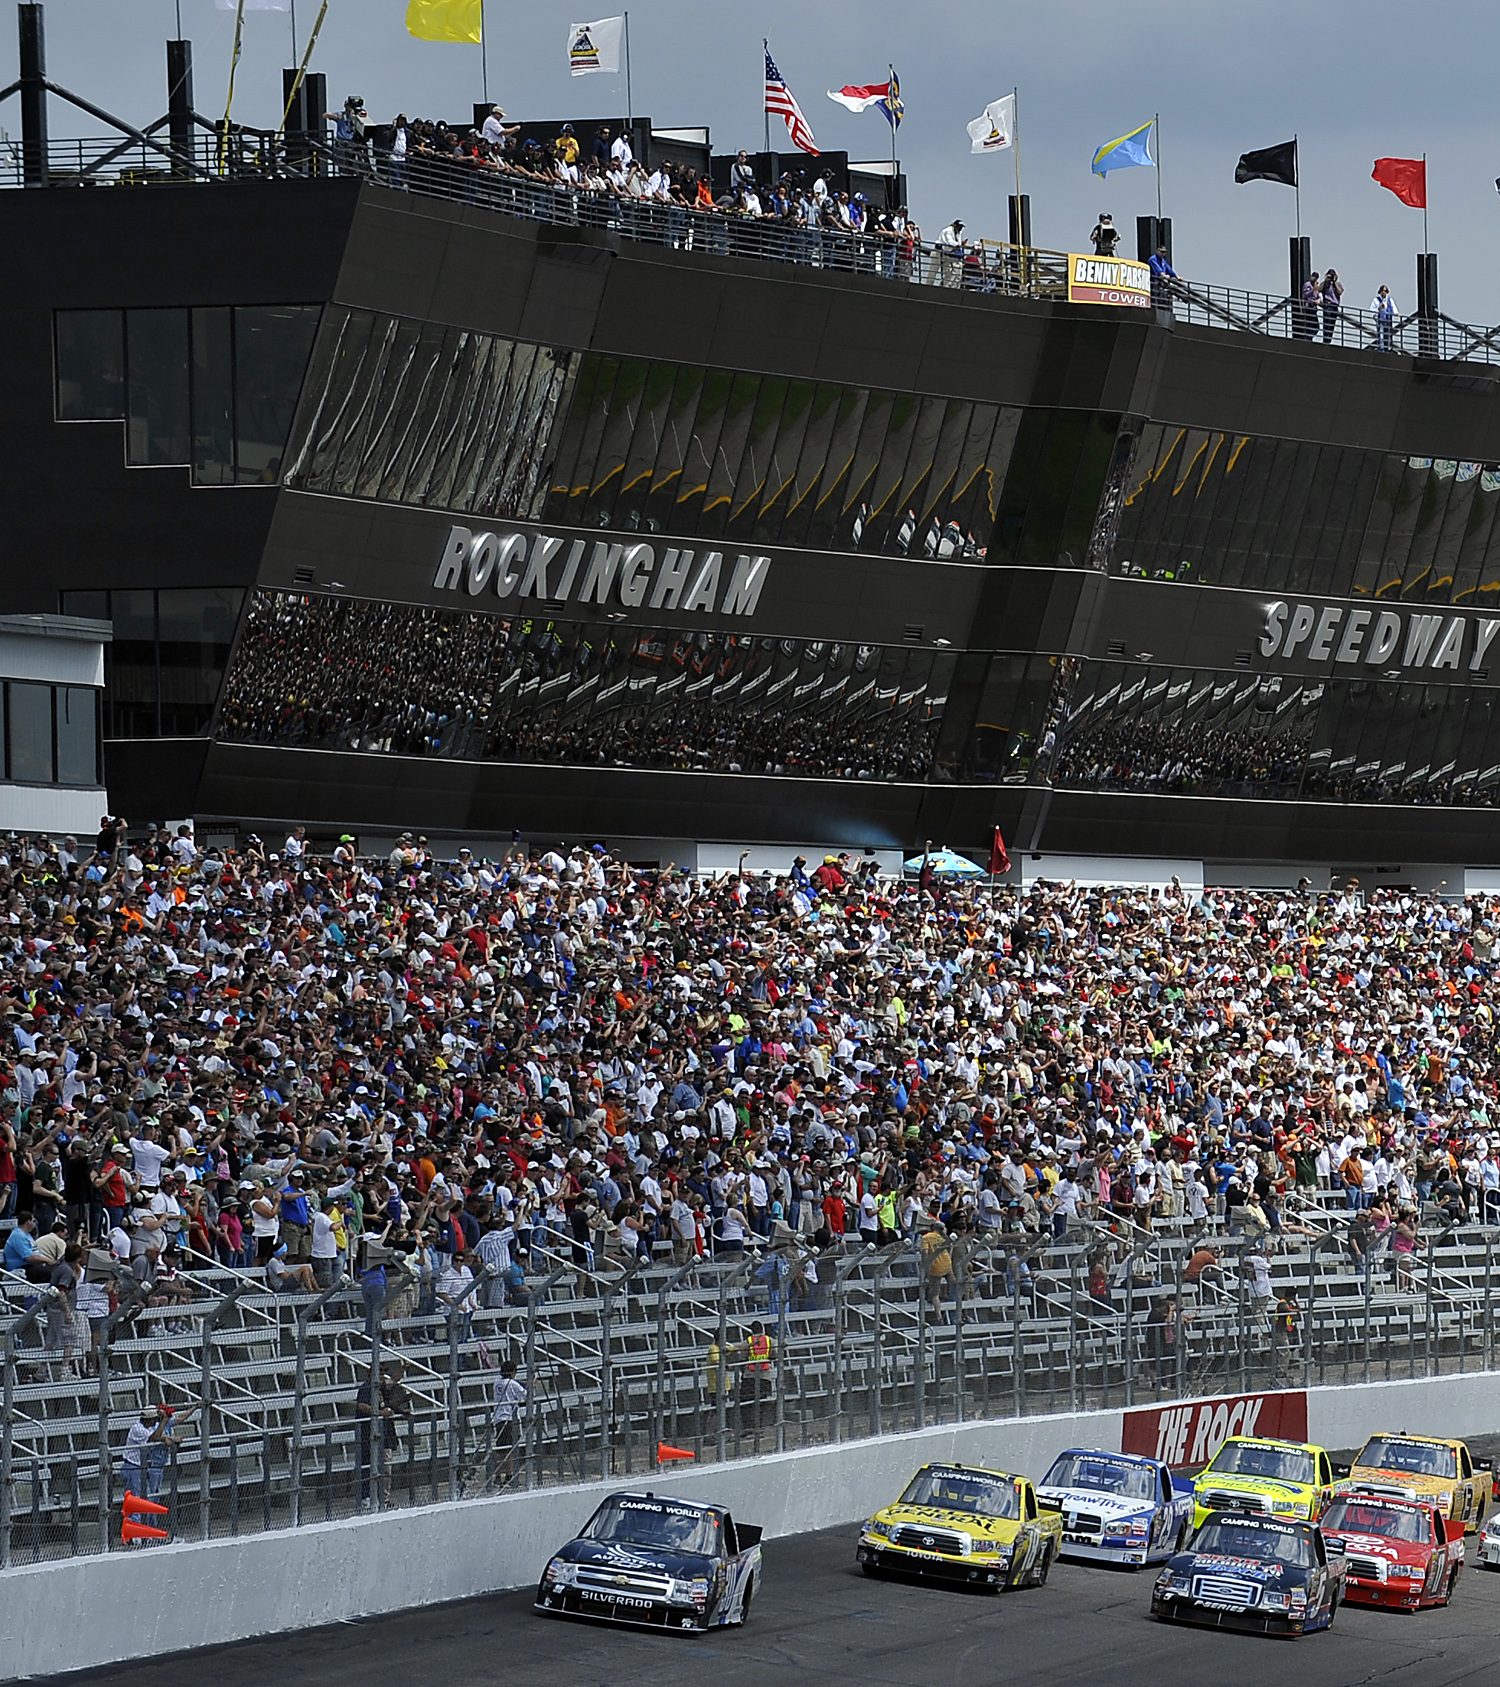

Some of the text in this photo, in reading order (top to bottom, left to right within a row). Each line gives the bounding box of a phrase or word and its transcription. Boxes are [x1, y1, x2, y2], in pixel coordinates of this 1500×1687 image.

[1075, 258, 1119, 286] BENNY
[1098, 291, 1146, 306] TOWER
[433, 525, 772, 616] ROCKINGHAM
[1155, 1398, 1264, 1465] THE ROCK
[1237, 1442, 1302, 1455] CAMPING WORLD
[1381, 1438, 1444, 1450] CAMPING WORLD
[1073, 1455, 1143, 1470] CAMPING WORLD
[931, 1471, 1005, 1487] CAMPING WORLD
[619, 1501, 701, 1518] CAMPING WORLD
[1346, 1497, 1416, 1513] CAMPING WORLD
[887, 1508, 997, 1534] GENERAL
[1221, 1518, 1295, 1534] CAMPING WORLD
[592, 1553, 667, 1569] AUTOTRAC
[906, 1550, 943, 1562] TOYOTA
[581, 1591, 654, 1609] SILVERADO
